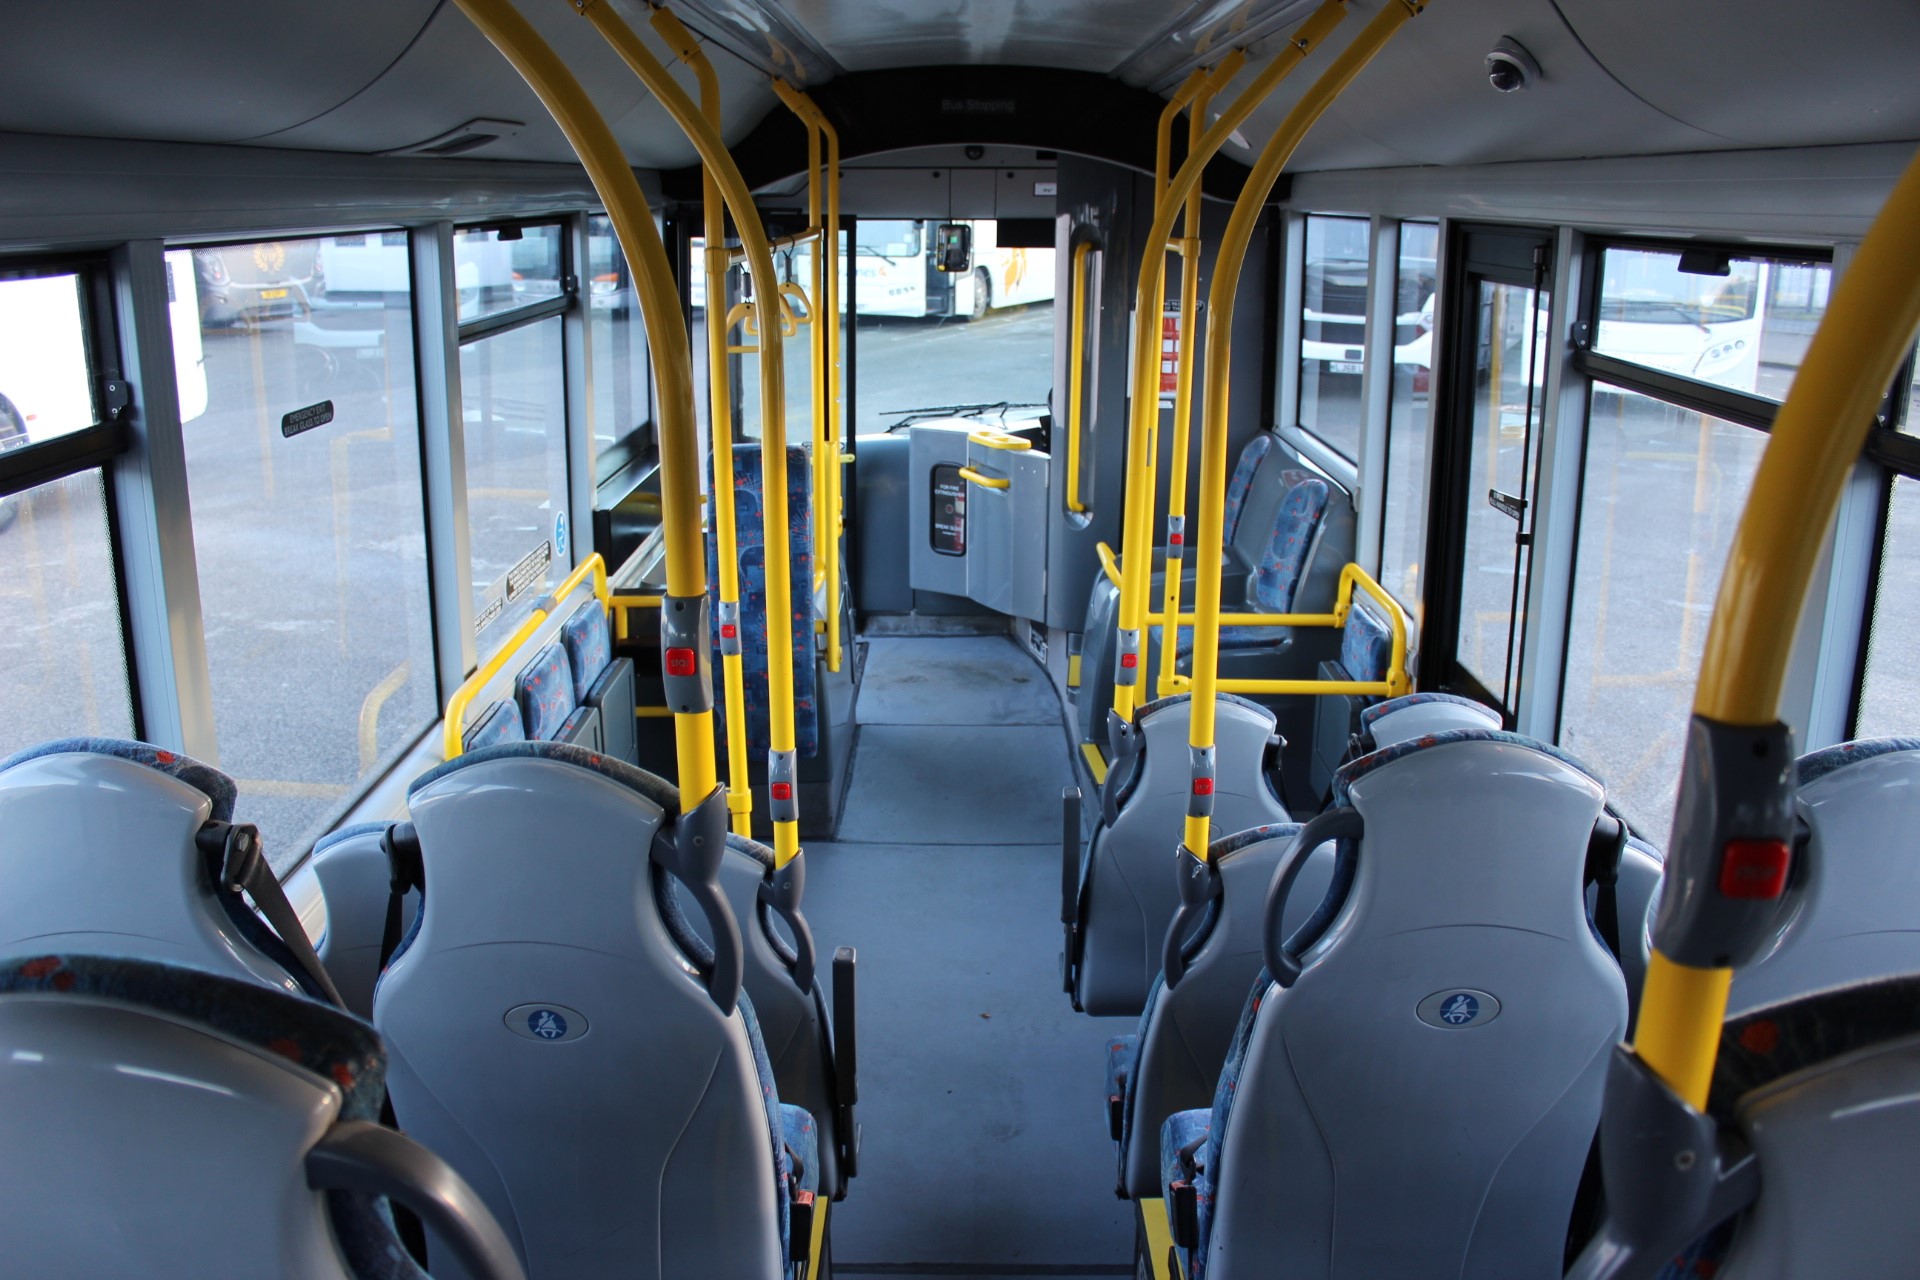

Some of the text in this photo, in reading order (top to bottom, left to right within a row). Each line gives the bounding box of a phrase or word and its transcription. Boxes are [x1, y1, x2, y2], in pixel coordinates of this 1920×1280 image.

[942, 99, 1015, 113] Bus Stopping
[289, 408, 316, 423] EMERGENCY
